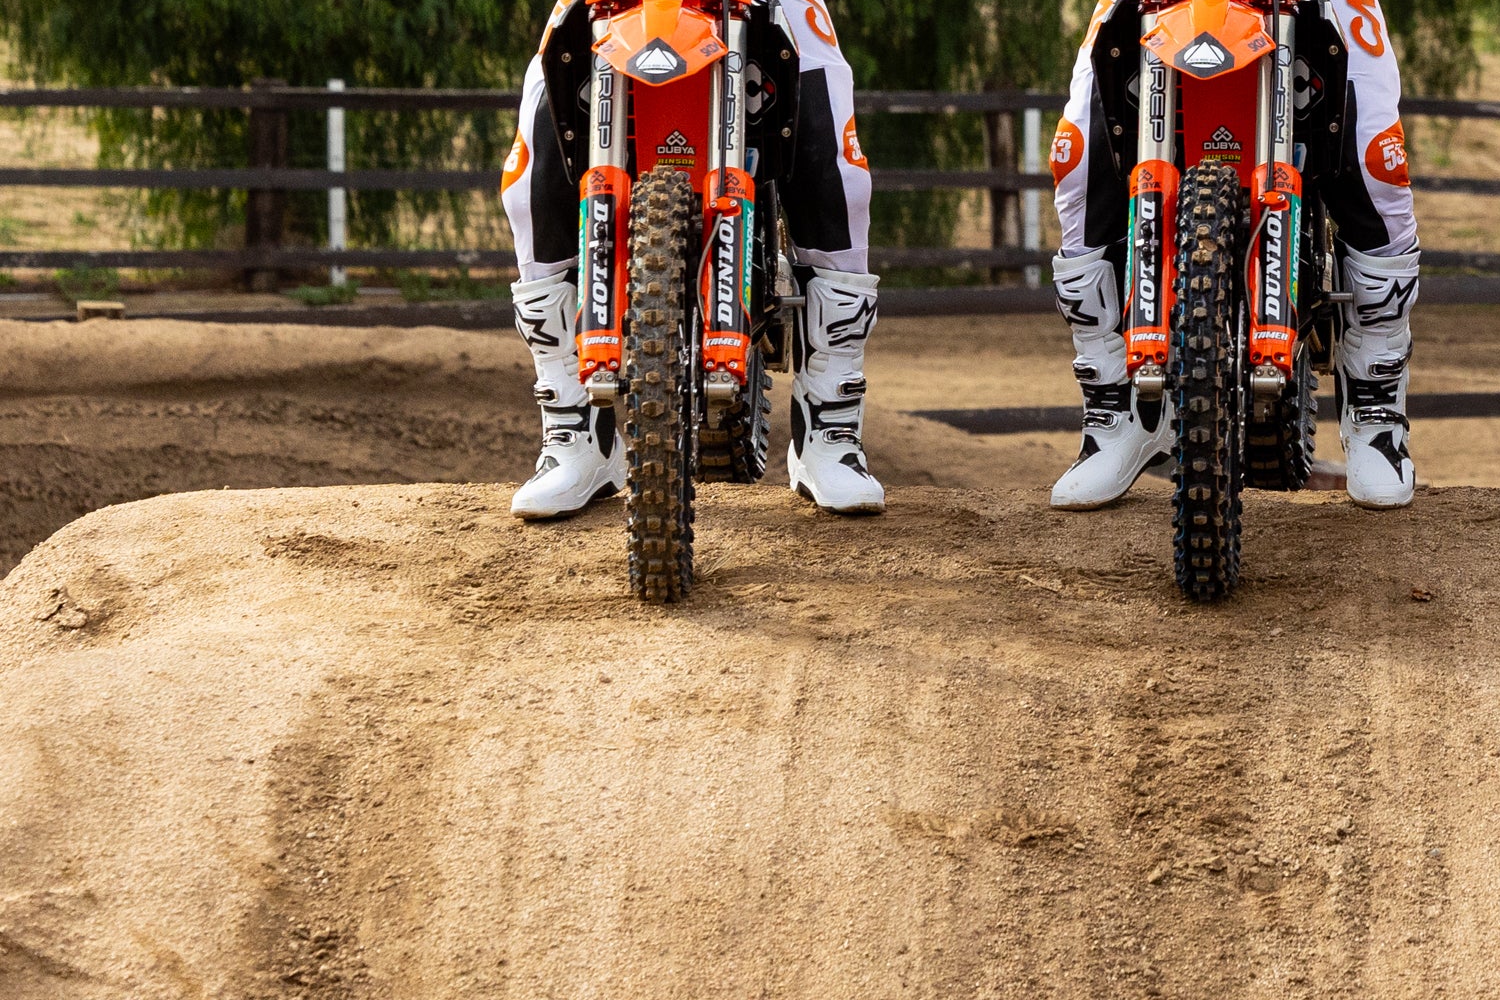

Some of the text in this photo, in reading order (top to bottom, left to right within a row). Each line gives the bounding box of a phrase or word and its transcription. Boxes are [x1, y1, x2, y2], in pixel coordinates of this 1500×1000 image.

[1150, 68, 1165, 142] REP
[598, 73, 613, 148] REP
[657, 146, 694, 154] DUBYA
[1204, 142, 1241, 150] DUBYA
[583, 336, 619, 345] TAMER
[1131, 332, 1166, 342] TAMER
[1254, 332, 1289, 341] TAMER
[706, 337, 741, 346] TAMER
